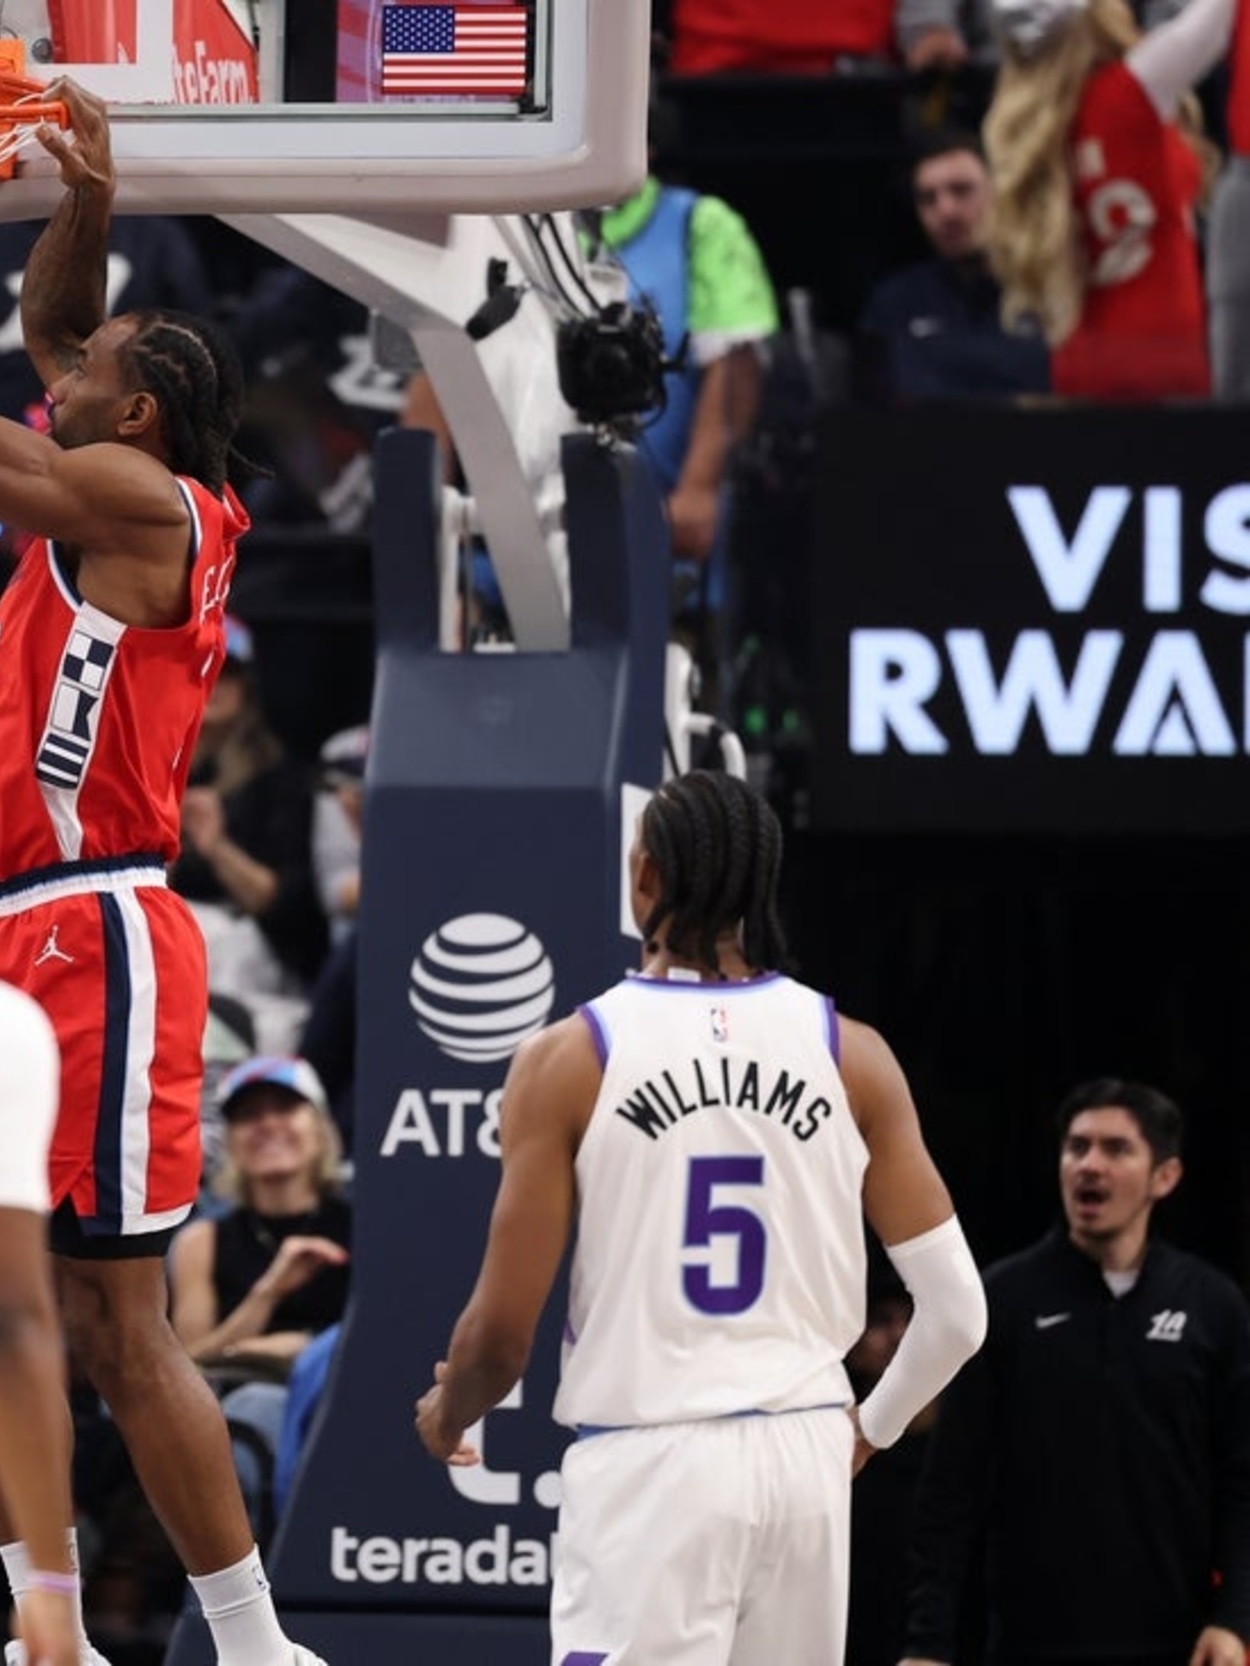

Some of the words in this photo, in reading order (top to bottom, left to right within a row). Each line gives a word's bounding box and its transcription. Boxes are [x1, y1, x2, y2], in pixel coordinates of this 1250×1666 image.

[1005, 482, 1250, 616] VIS
[848, 627, 1250, 756] RWA
[615, 1056, 832, 1142] WILLIAMS
[681, 1155, 768, 1316] 5
